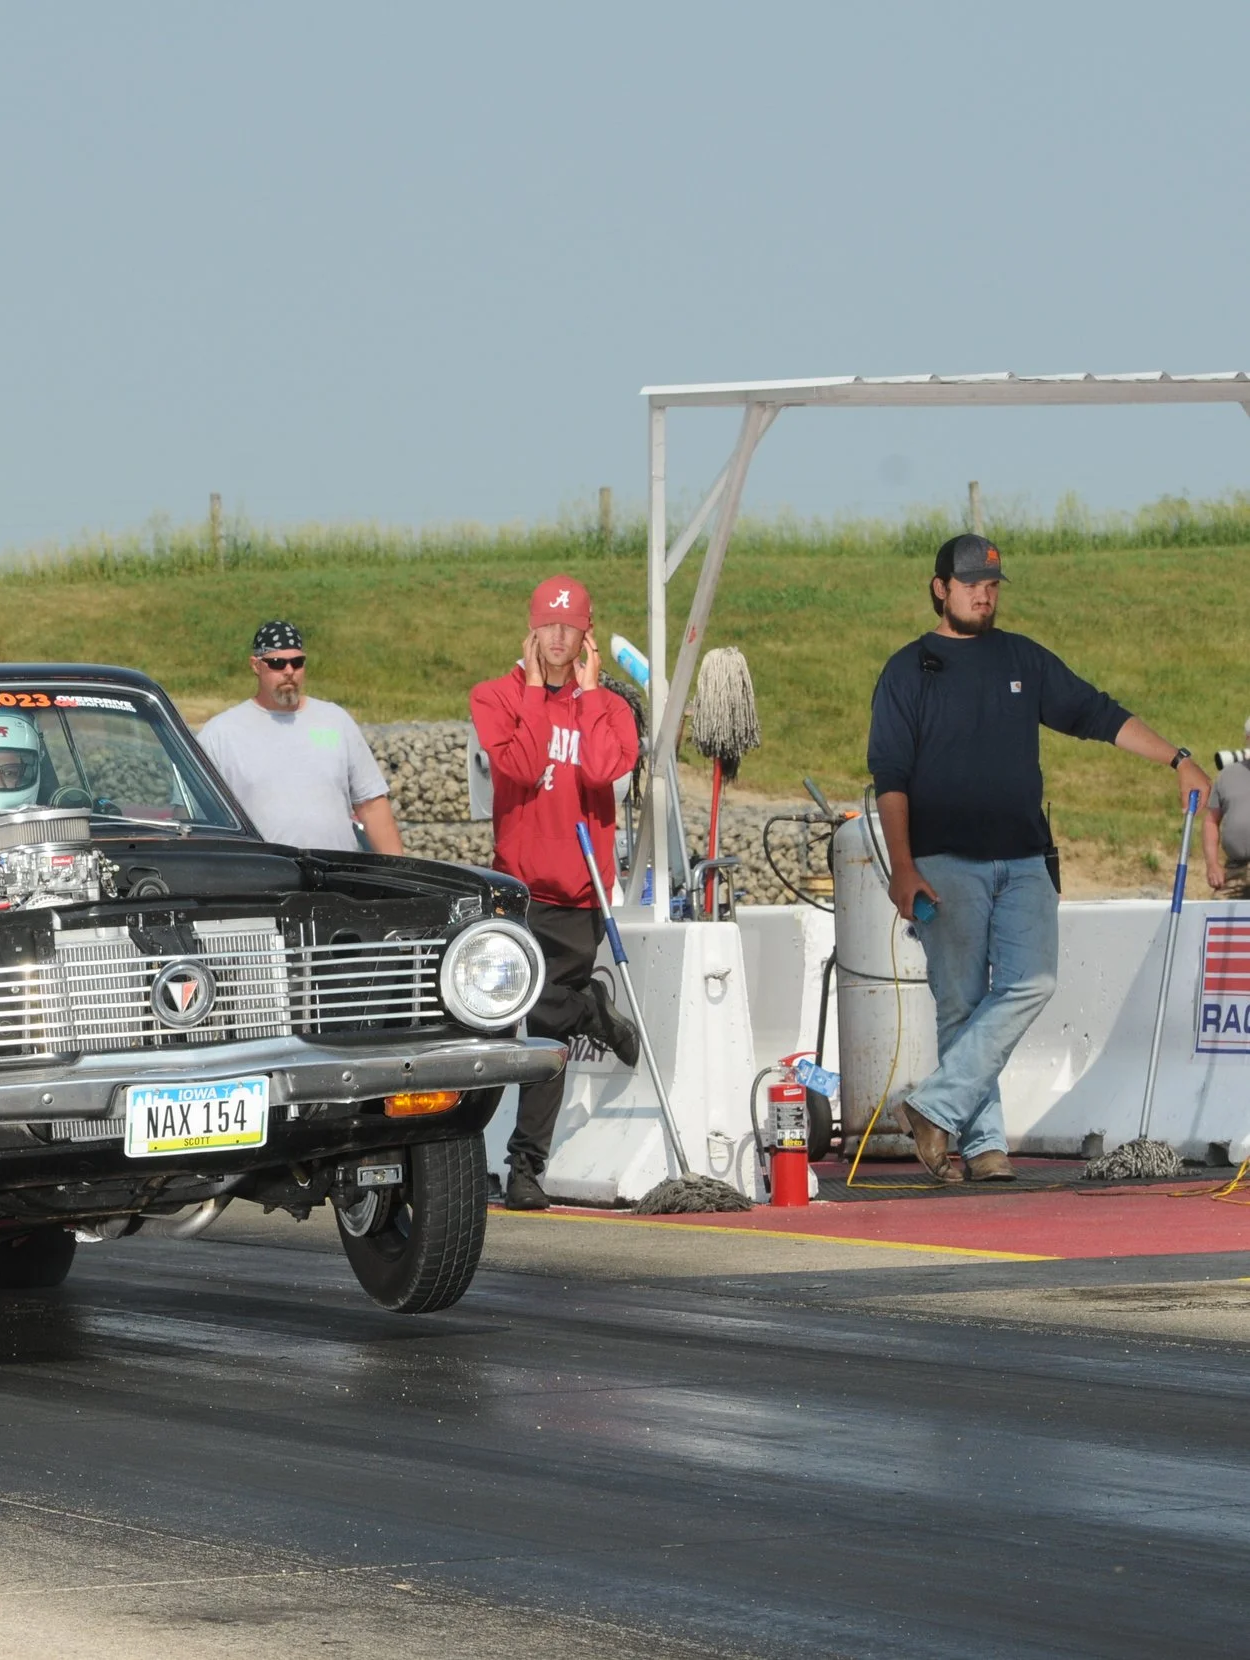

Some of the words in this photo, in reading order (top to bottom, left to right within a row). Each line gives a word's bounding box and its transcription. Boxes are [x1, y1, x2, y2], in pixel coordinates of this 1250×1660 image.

[178, 1087, 217, 1101] IOWA
[146, 1102, 192, 1139] NAX
[203, 1099, 248, 1134] 154
[183, 1136, 211, 1147] SCOTT
